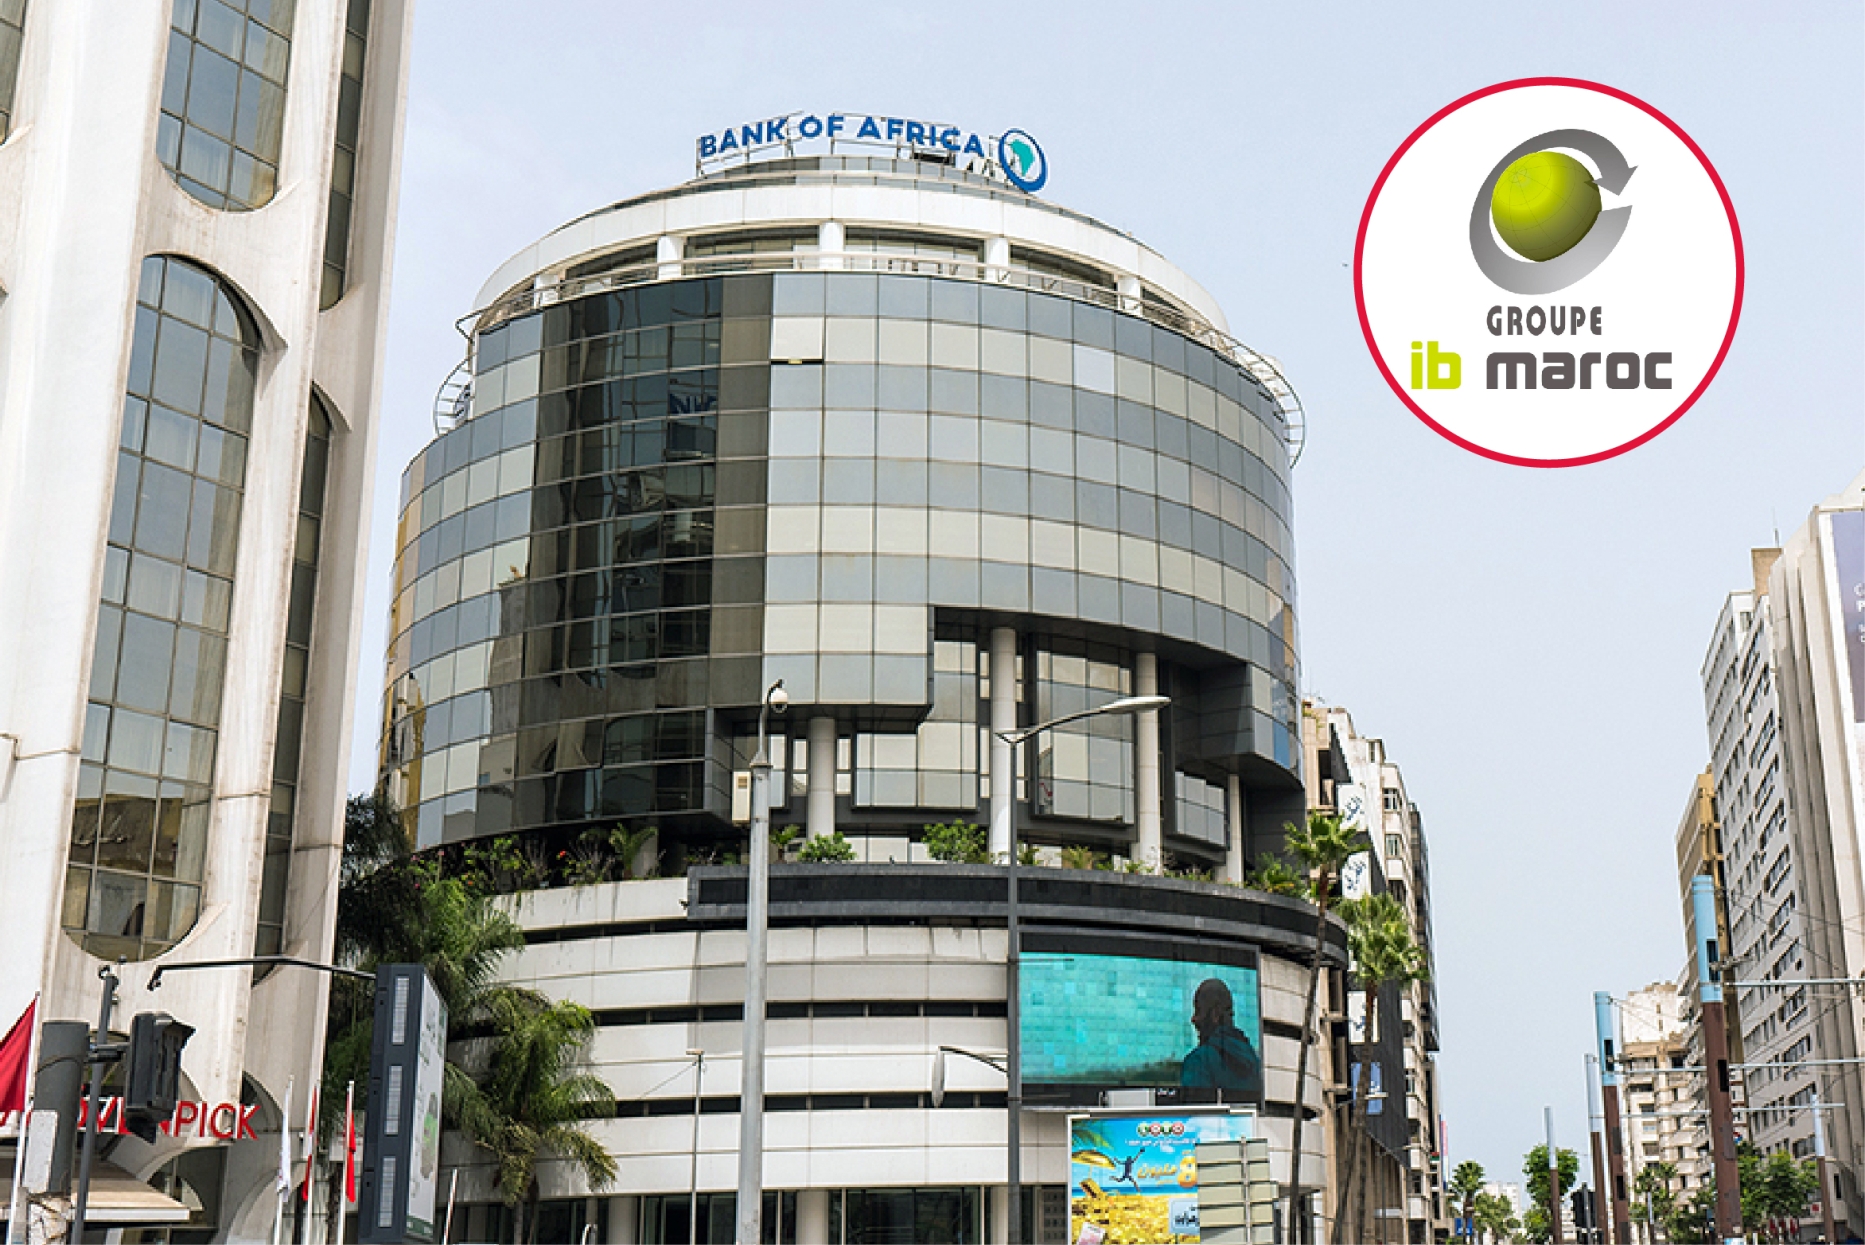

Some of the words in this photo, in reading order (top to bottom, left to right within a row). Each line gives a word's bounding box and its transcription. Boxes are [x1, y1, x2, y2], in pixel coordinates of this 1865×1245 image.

[700, 117, 788, 158] BANK
[800, 115, 844, 138] OF
[856, 116, 985, 157] AFRICA
